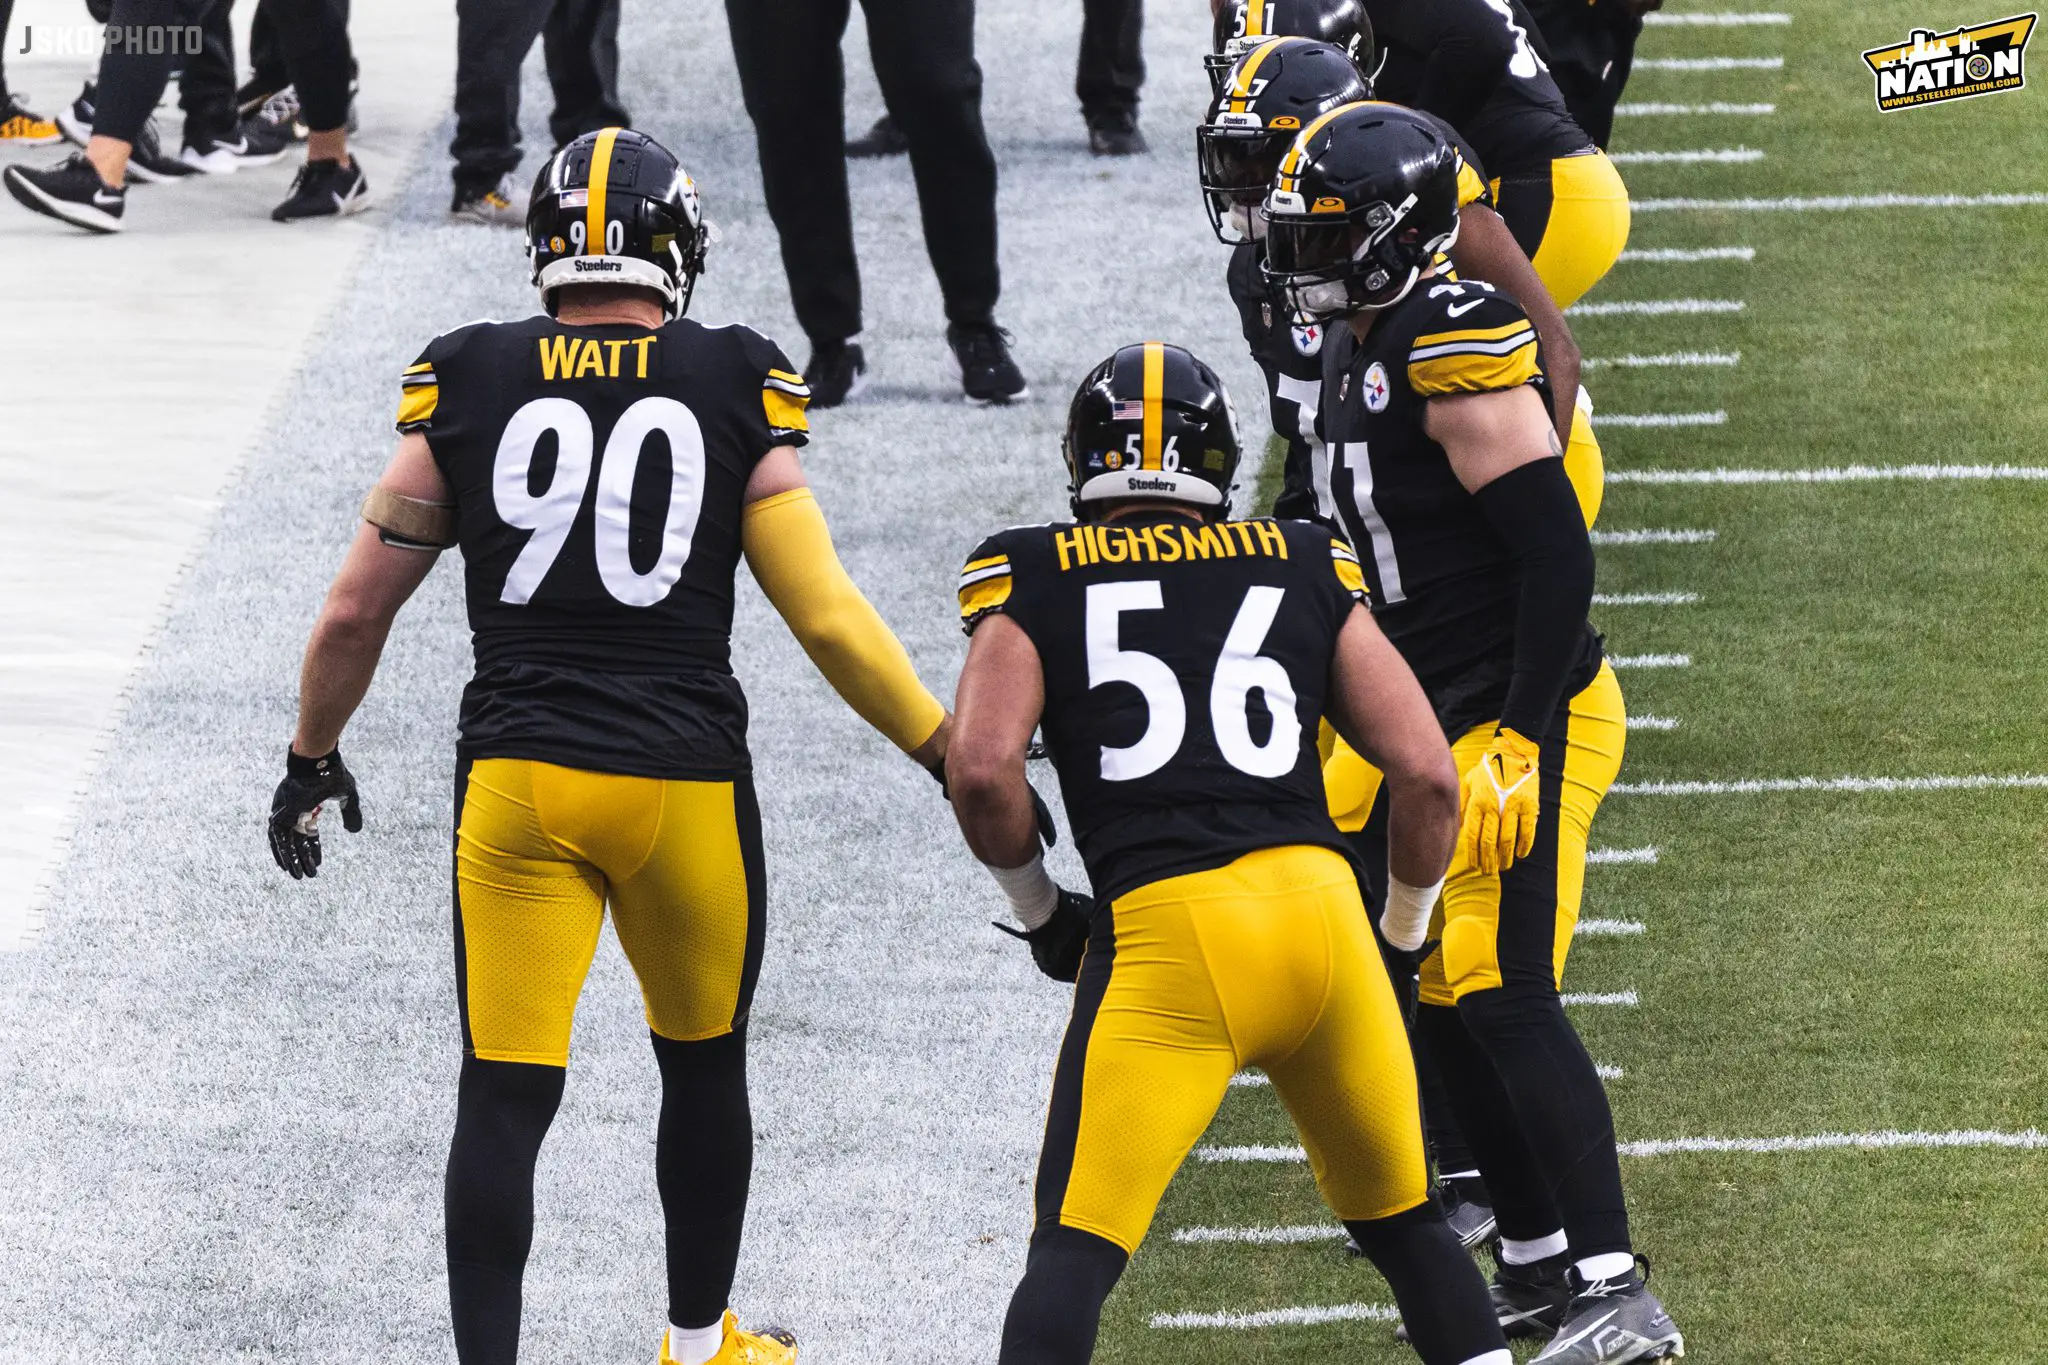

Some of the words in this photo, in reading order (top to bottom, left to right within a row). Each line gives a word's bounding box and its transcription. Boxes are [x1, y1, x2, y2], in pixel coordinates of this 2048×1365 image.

[1233, 3, 1275, 37] 51
[569, 219, 624, 256] 90
[574, 258, 623, 272] Steelers
[538, 335, 657, 380] WATT
[1123, 433, 1180, 473] 56
[492, 396, 706, 608] 90
[1128, 477, 1177, 492] Steelers
[1055, 521, 1289, 572] HIGHSMITH
[1085, 580, 1302, 782] 56
